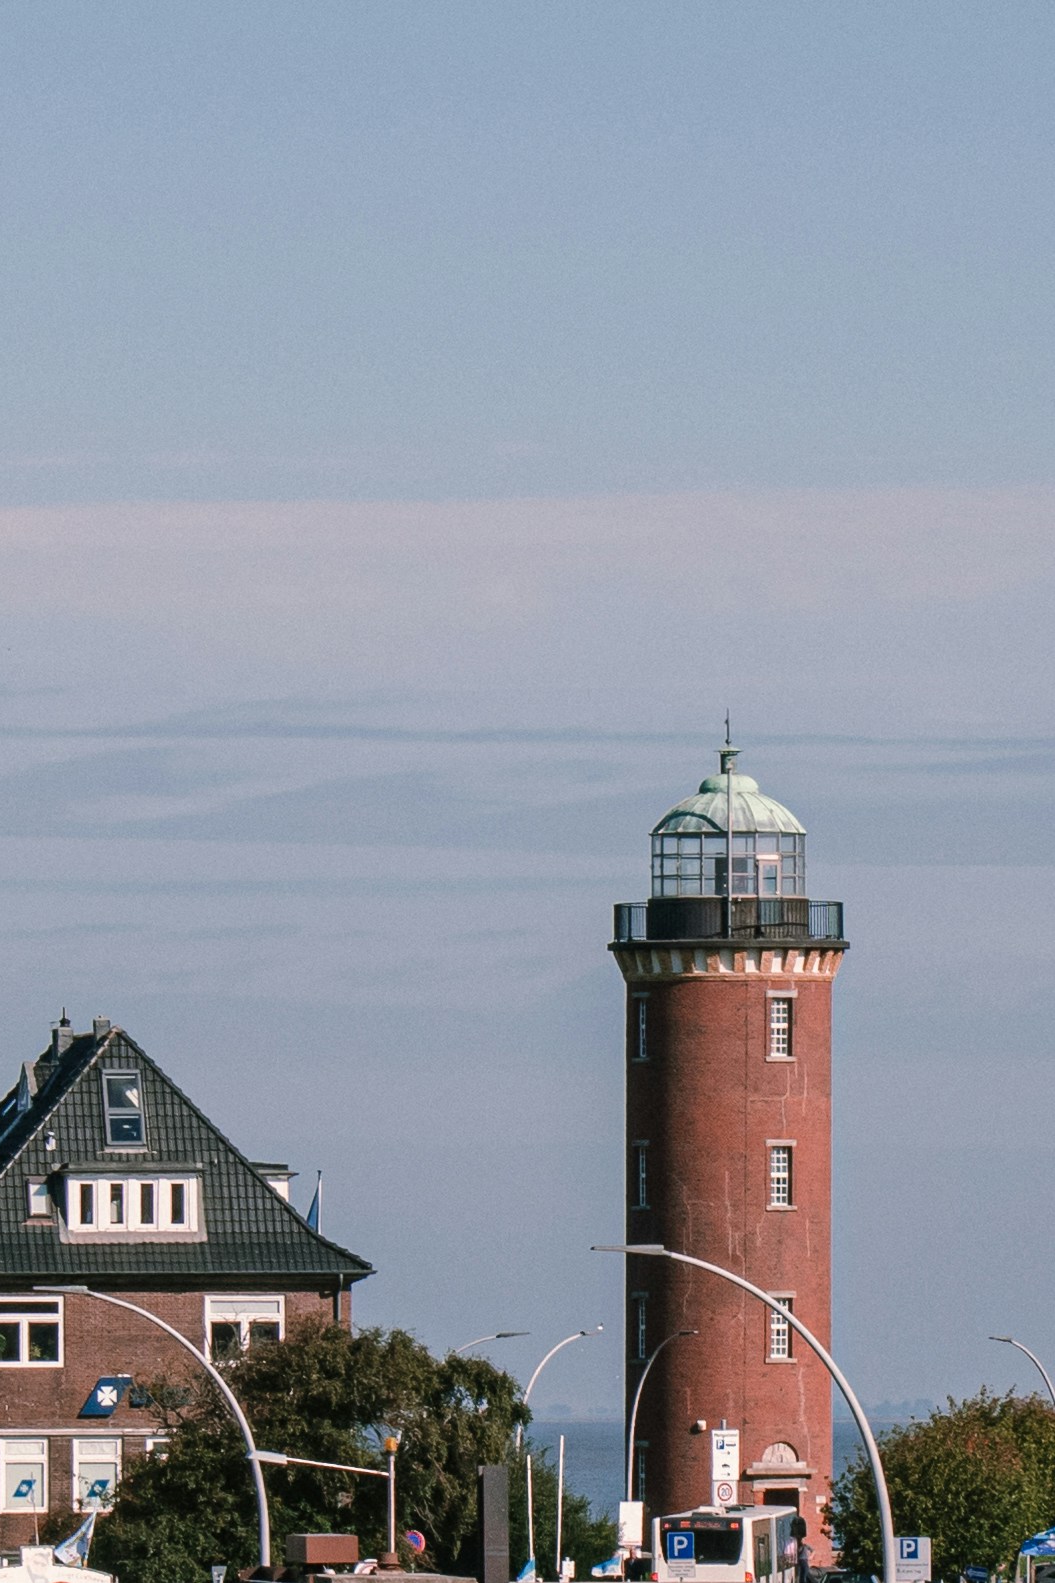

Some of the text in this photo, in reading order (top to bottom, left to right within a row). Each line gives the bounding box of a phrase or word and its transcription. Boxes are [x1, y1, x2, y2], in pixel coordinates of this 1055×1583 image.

[721, 1487, 730, 1497] 20
[673, 1535, 688, 1557] P
[902, 1540, 916, 1558] P
